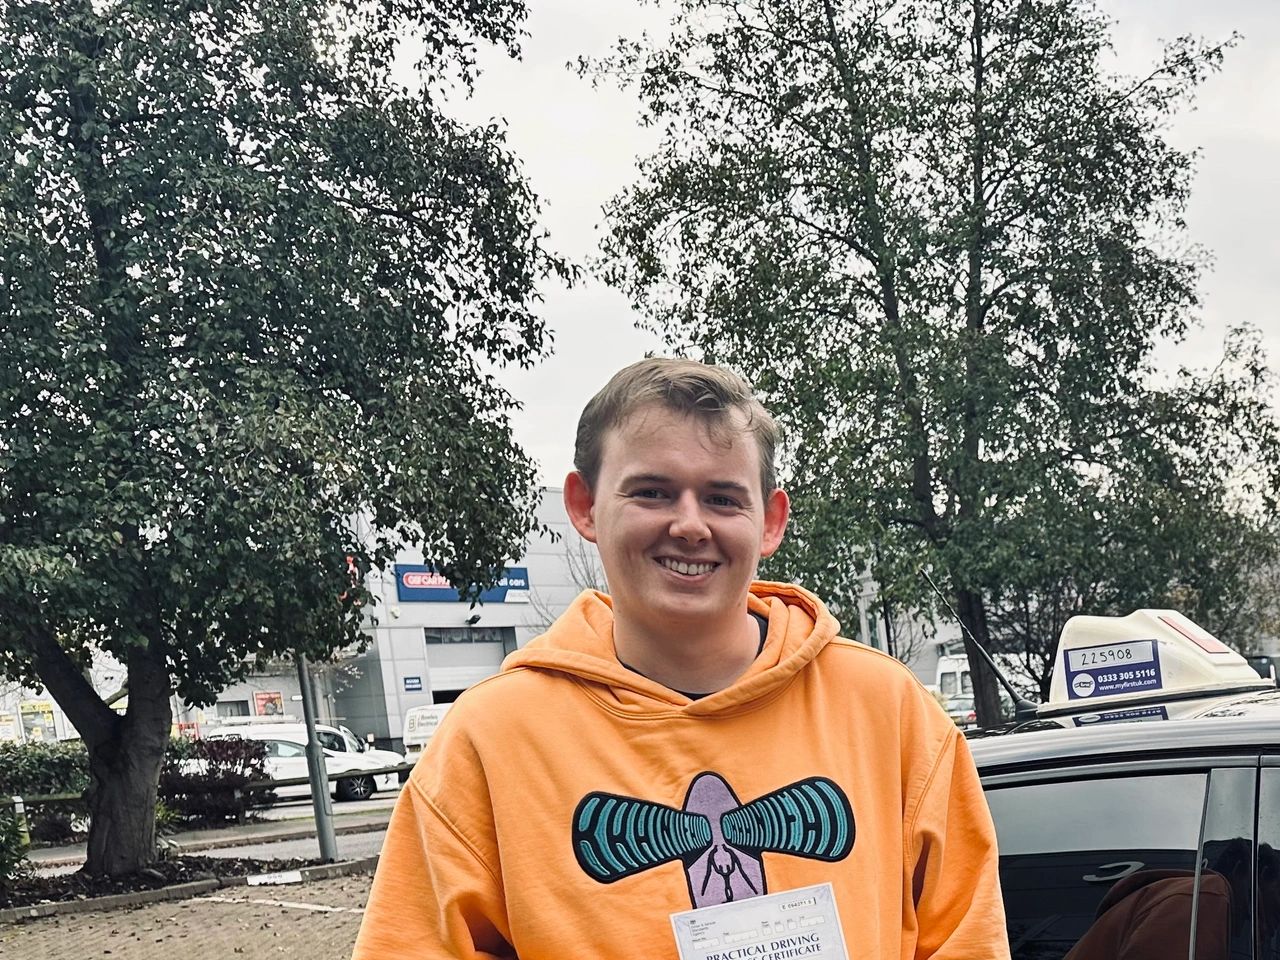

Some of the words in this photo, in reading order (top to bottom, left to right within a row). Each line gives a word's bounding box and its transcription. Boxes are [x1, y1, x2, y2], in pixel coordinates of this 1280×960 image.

[509, 578, 525, 587] cars
[1081, 648, 1133, 666] 225908
[1097, 673, 1118, 684] 0333
[1119, 671, 1134, 681] 305
[1135, 668, 1156, 678] 5116
[1098, 677, 1157, 692] www.myfirstuk.com
[770, 932, 820, 950] DRIVING
